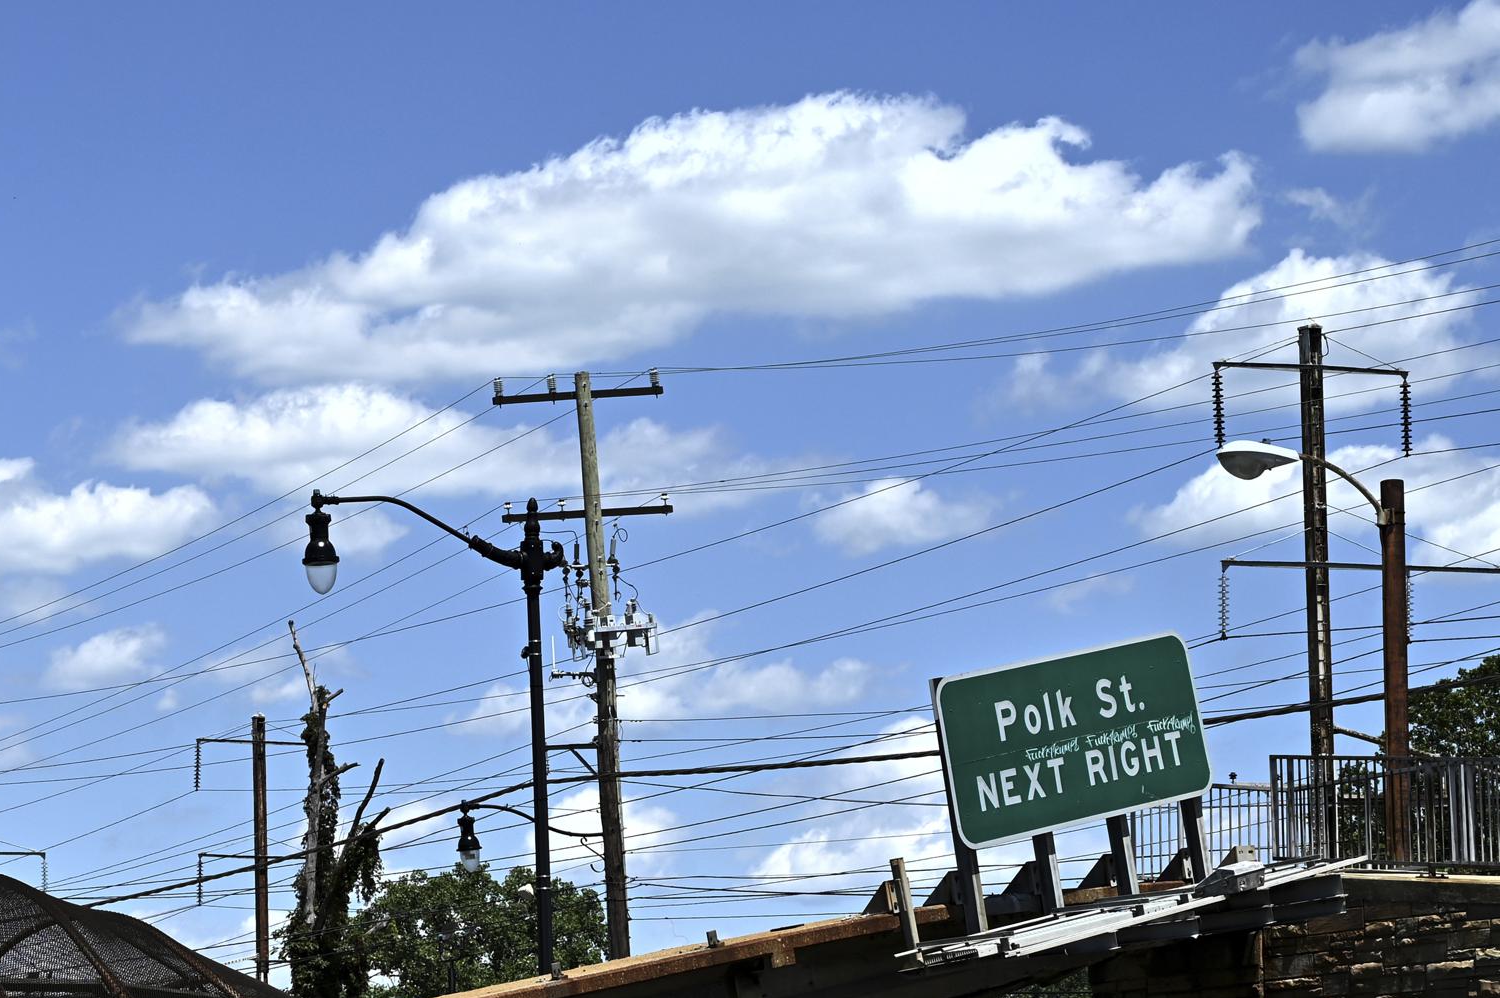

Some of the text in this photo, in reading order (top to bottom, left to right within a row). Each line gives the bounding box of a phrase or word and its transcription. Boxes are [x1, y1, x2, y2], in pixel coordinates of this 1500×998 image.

[994, 675, 1145, 742] Polk St.
[976, 731, 1181, 812] NEXT RIGHT
